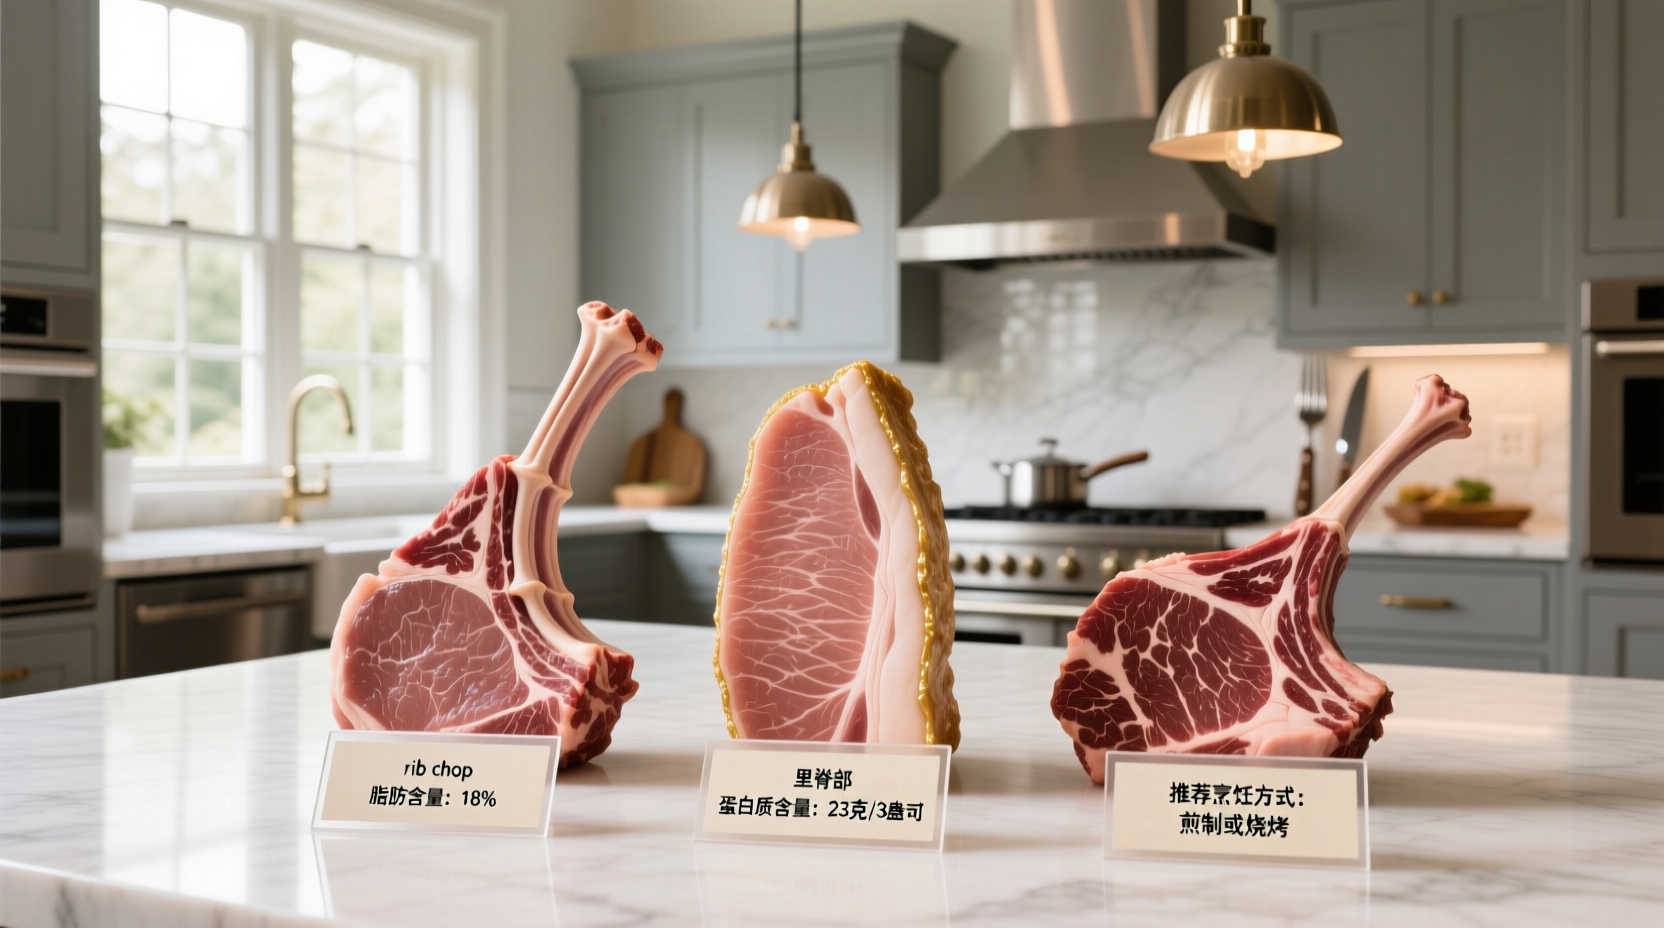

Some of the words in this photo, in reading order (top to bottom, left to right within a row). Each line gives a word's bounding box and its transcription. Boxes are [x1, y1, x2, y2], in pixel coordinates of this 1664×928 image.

[403, 758, 427, 777] rib
[431, 759, 474, 782] chop
[1178, 810, 1290, 839] 煎制或烧烤
